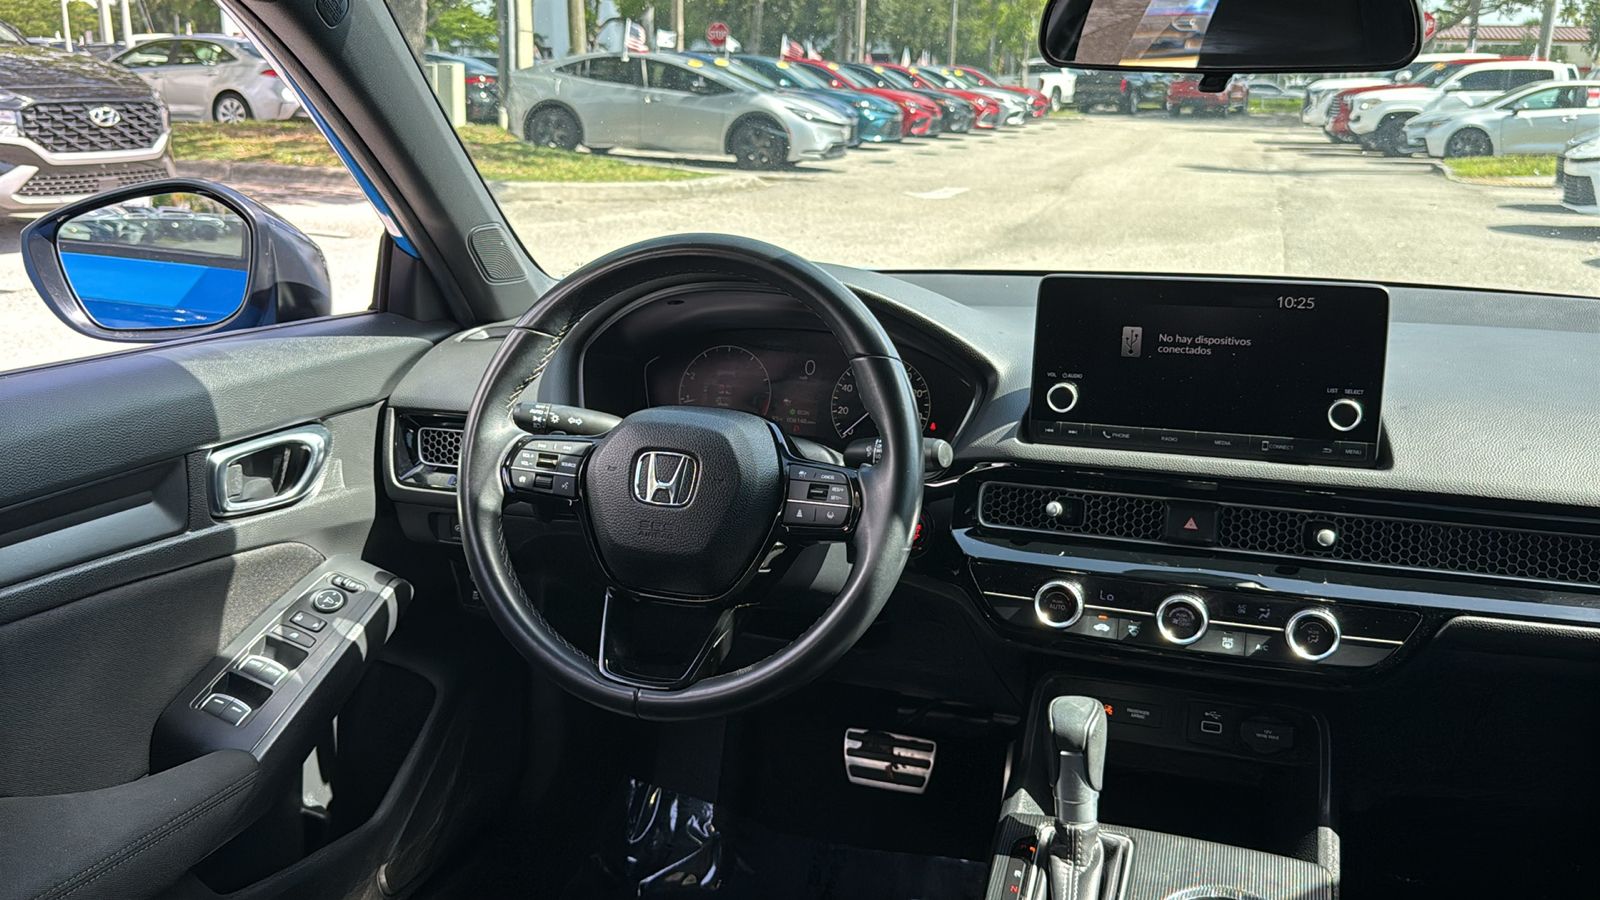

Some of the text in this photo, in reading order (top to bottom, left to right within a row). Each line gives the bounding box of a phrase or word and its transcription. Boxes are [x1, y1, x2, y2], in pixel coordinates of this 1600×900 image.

[1277, 297, 1316, 310] 10:25
[1158, 334, 1252, 347] No hay dispositivos
[1157, 345, 1212, 356] conectados
[804, 359, 816, 376] 0
[1047, 371, 1058, 379] VOL
[841, 383, 854, 393] 40
[837, 406, 849, 416] 20
[793, 425, 800, 433] P
[1111, 432, 1131, 440] PHONE
[1160, 435, 1178, 443] RADIO
[1269, 443, 1294, 451] CONNECT
[1099, 590, 1115, 602] Lo
[1049, 604, 1067, 612] AUTO
[1010, 885, 1018, 893] N
